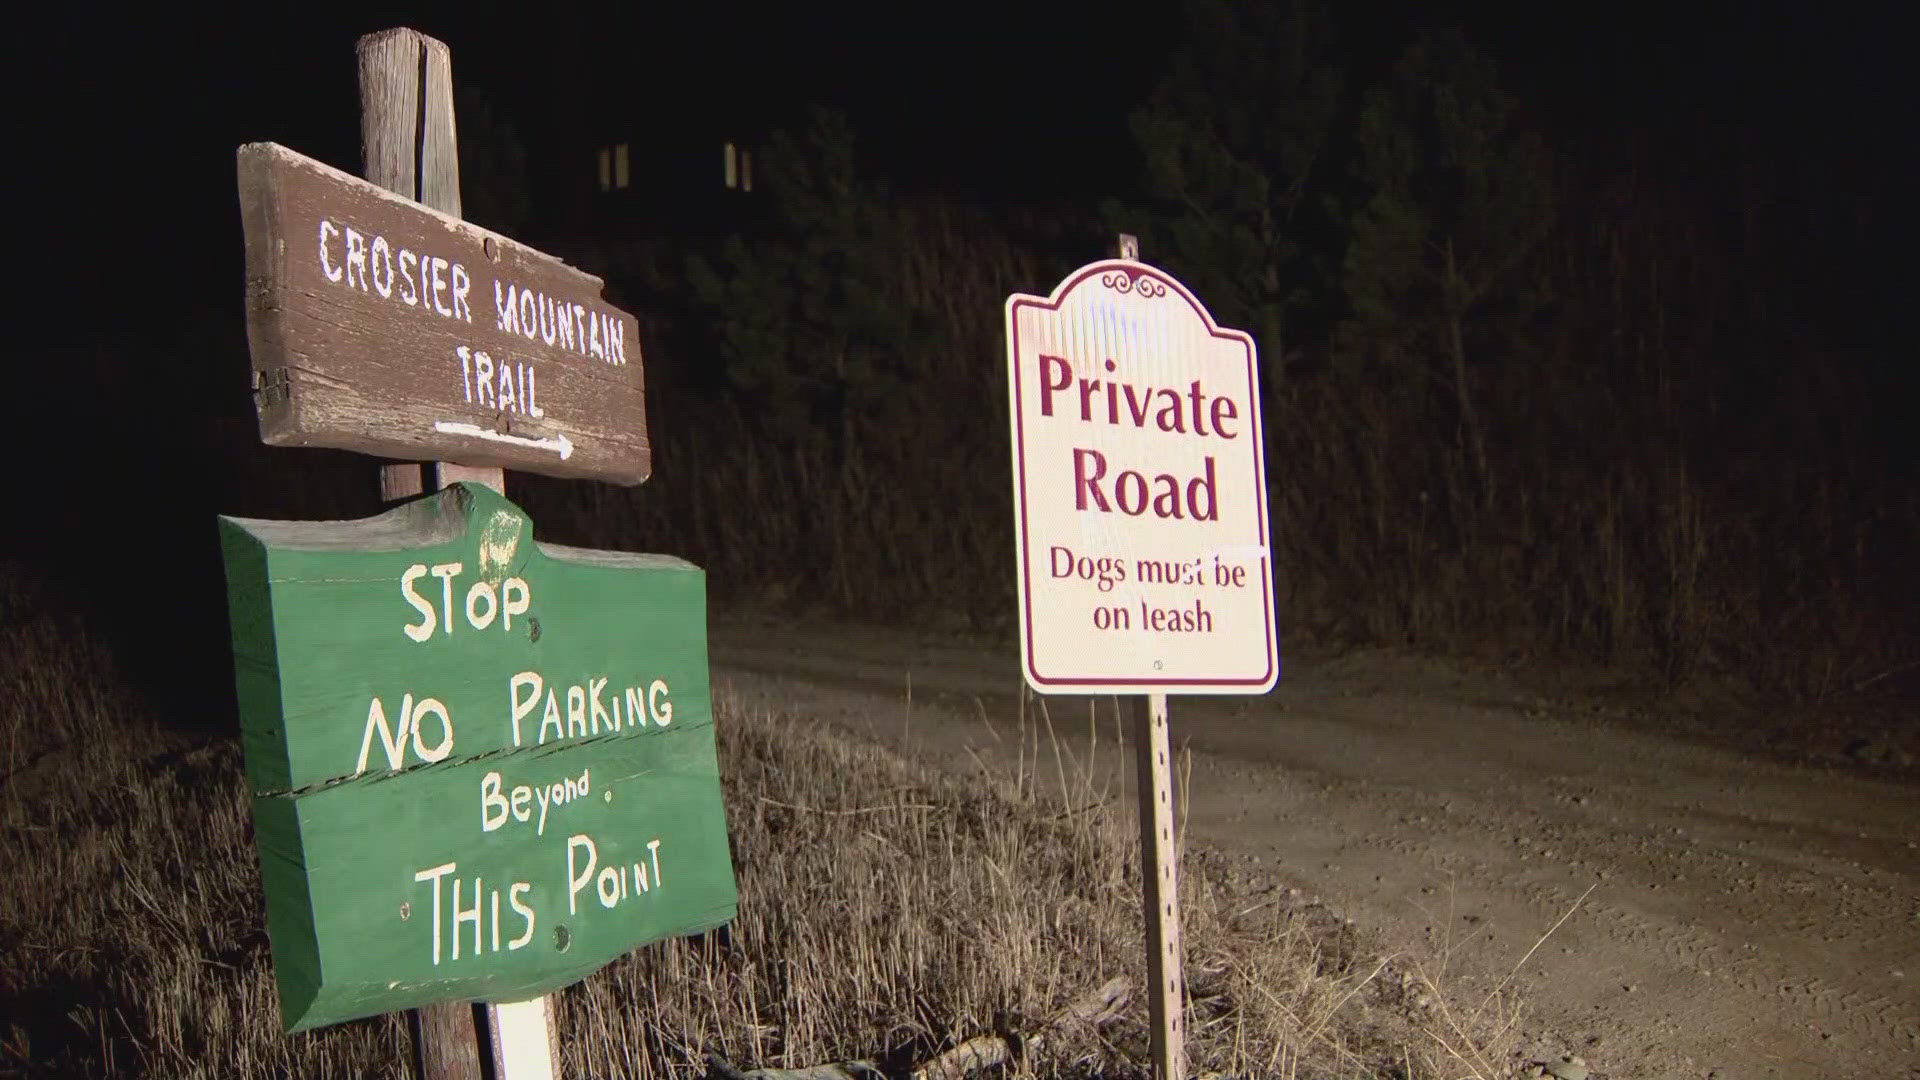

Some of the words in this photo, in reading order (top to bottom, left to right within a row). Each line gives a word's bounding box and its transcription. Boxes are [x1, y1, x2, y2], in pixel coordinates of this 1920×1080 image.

[319, 220, 472, 323] CROSIER
[494, 280, 627, 366] MOUNTAIN
[457, 346, 544, 418] TRAIL
[1038, 354, 1239, 439] Private
[1073, 447, 1219, 522] Road
[1050, 546, 1126, 592] Dogs
[1137, 557, 1205, 586] must
[1214, 556, 1246, 588] be
[1093, 603, 1130, 631] on
[1141, 600, 1213, 633] leash
[356, 693, 453, 772] NO
[510, 671, 673, 746] PARKING
[480, 768, 590, 836] Beyond
[415, 862, 535, 965] THIS
[567, 834, 661, 916] POINT
